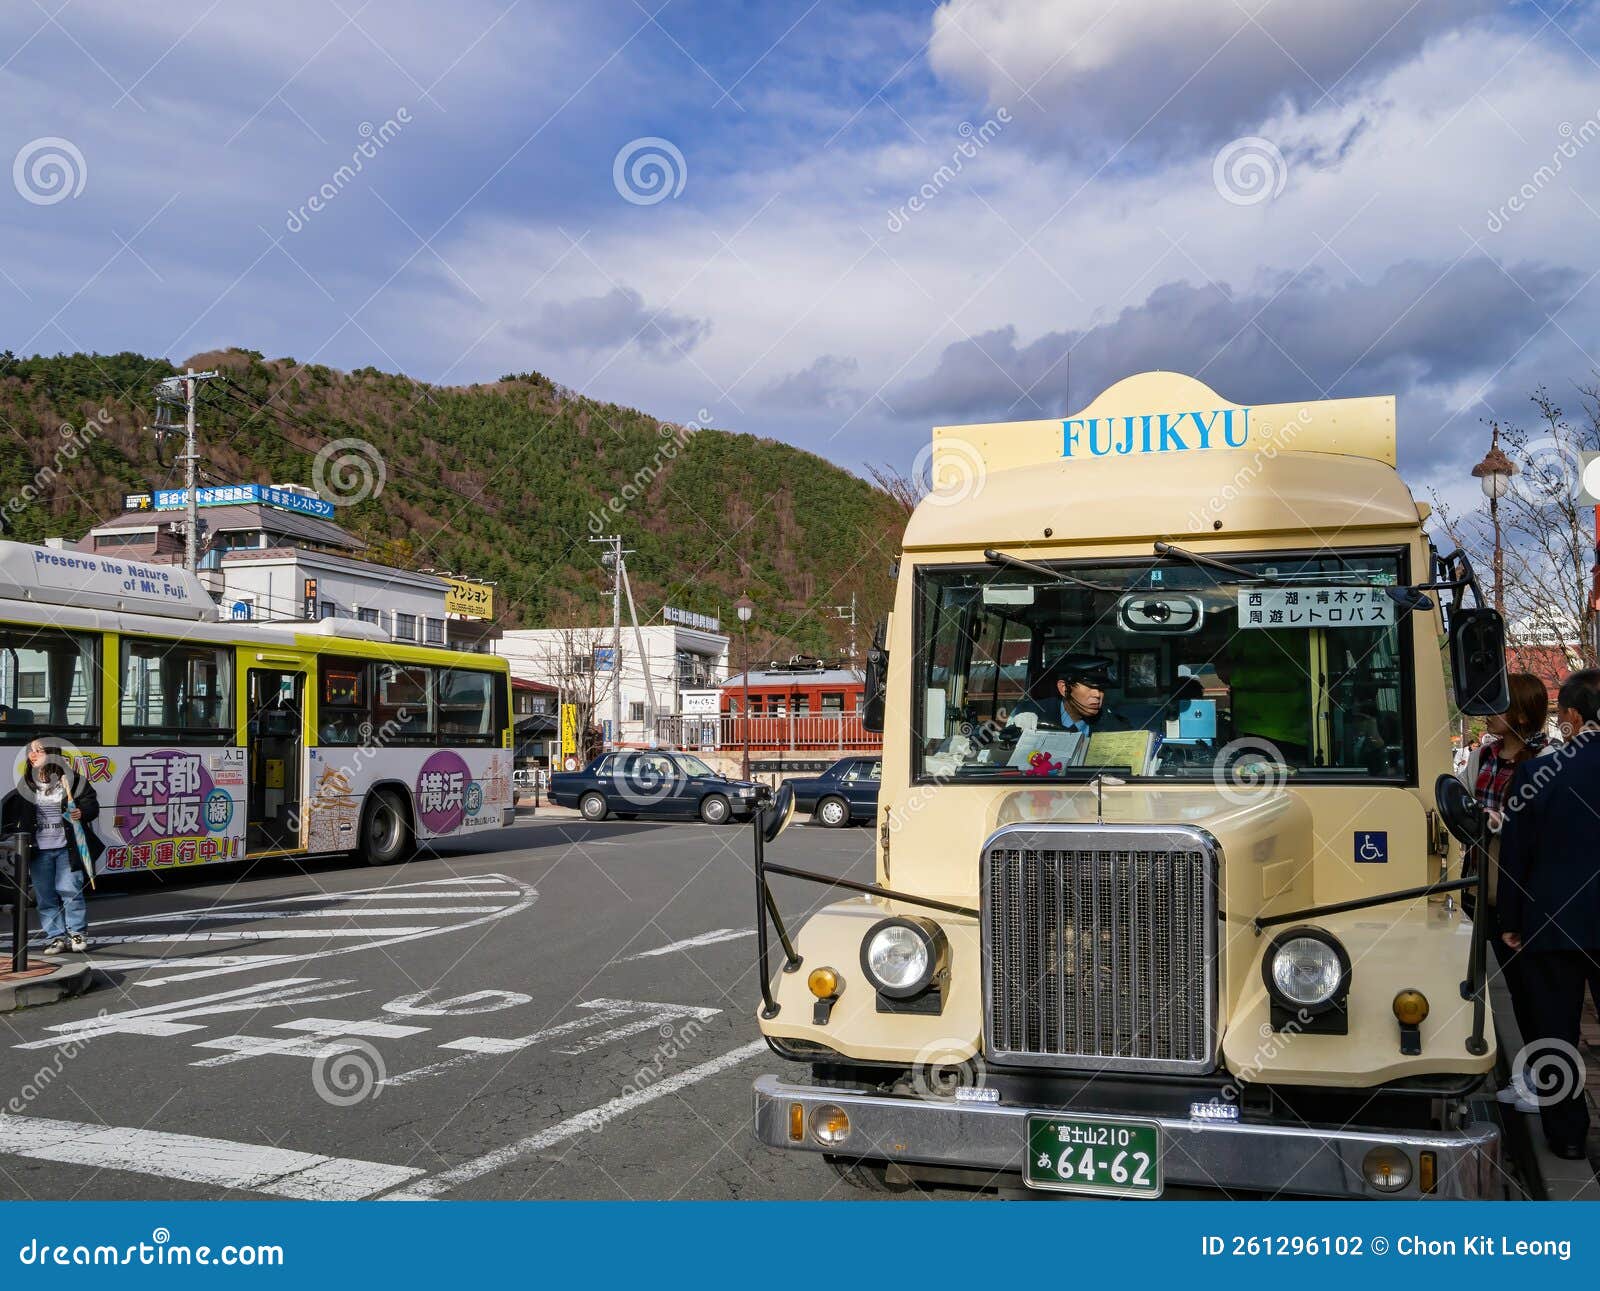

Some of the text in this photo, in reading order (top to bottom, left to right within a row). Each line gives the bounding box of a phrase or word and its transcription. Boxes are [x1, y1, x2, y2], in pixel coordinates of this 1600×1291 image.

[1060, 408, 1251, 457] FUJIKYU
[35, 551, 169, 581] Preserve the Nature
[123, 579, 188, 599] of Mt. Fuji.
[452, 585, 489, 603] マンション
[1249, 607, 1386, 624] 周遊レトロバス
[224, 750, 244, 760] 入口
[131, 755, 202, 796] 京都
[421, 772, 464, 814] 横浜
[131, 797, 201, 837] 大阪
[207, 795, 228, 824] 線
[1037, 1146, 1150, 1185] あ 64-62
